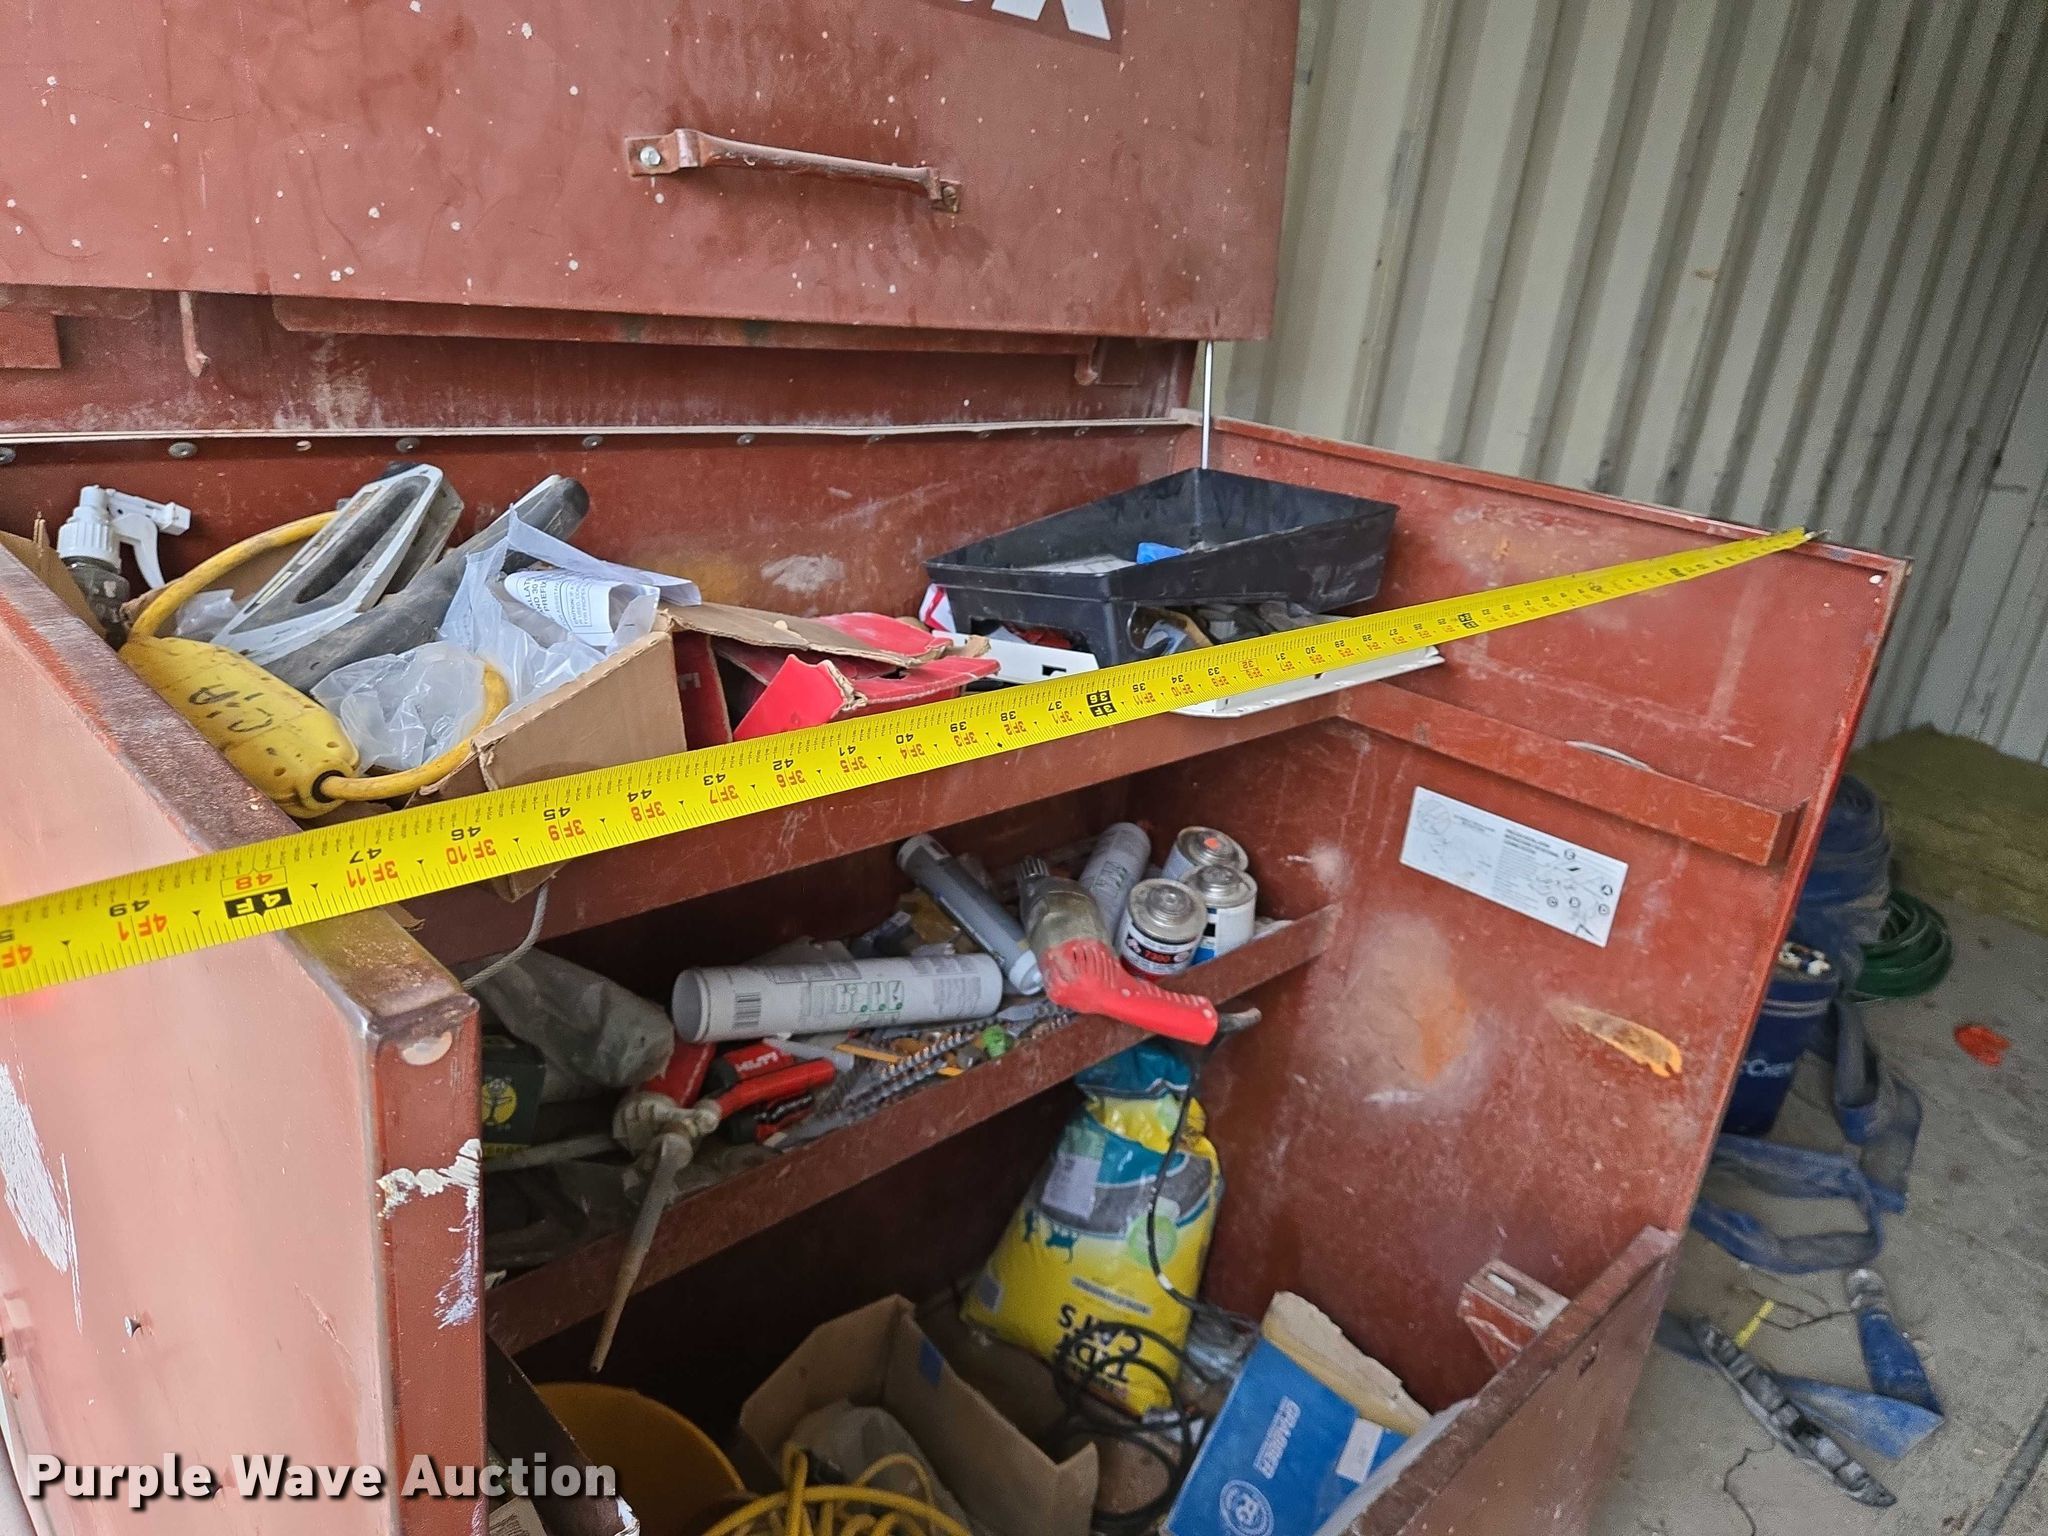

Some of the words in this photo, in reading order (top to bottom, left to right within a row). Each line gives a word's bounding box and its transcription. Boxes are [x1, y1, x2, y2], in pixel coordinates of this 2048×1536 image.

[1305, 646, 1316, 654] 30
[1275, 653, 1286, 661] 31
[1207, 666, 1220, 676] 33
[1171, 674, 1184, 684] 34
[1132, 682, 1146, 692] 35
[1089, 690, 1110, 704] 36
[1048, 701, 1063, 712] 37
[1000, 710, 1017, 722] 38
[950, 721, 968, 733] 39
[895, 733, 914, 745] 40
[839, 745, 856, 757] 41
[773, 758, 794, 771] 42
[703, 773, 726, 787] 43
[627, 788, 653, 802] 44
[543, 806, 571, 821] 45
[451, 826, 482, 841] 46
[349, 848, 382, 864] 47
[235, 873, 274, 890] 48
[109, 900, 150, 917] 49
[236, 893, 282, 915] 4F
